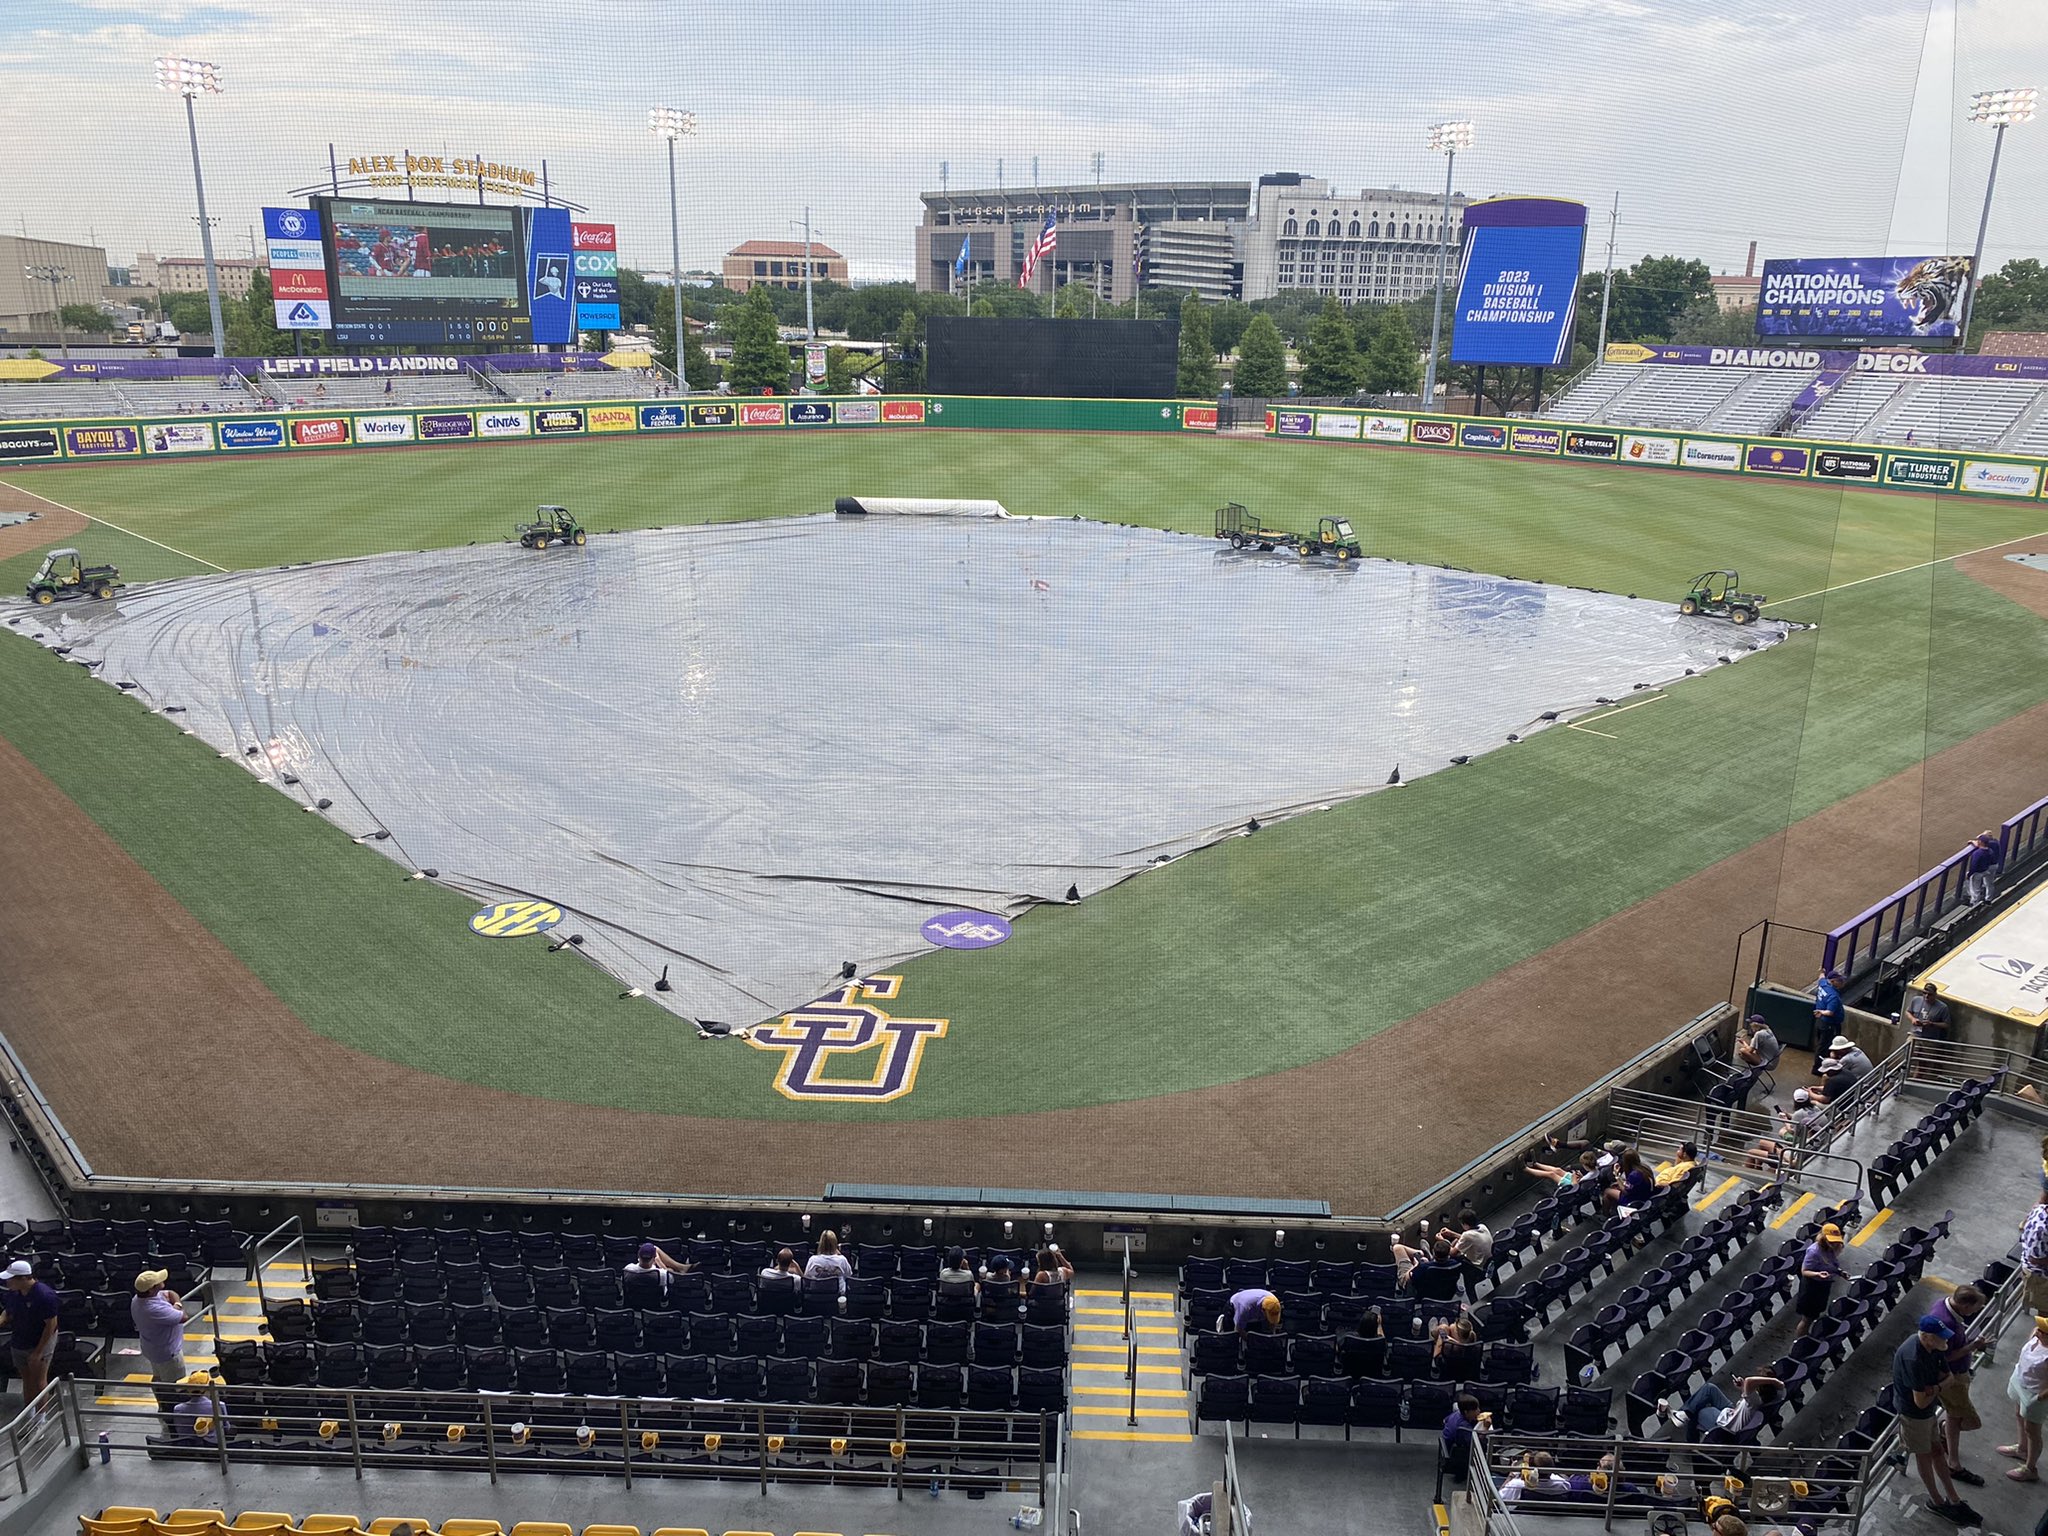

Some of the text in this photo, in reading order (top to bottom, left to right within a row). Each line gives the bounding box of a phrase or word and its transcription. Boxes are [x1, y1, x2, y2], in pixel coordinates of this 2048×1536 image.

[349, 155, 535, 187] ALEX BOX STADIUM
[369, 174, 523, 197] SKIP BERTMAN FIELD
[959, 206, 1004, 215] TIGER
[272, 249, 298, 258] PEOPLES
[576, 255, 615, 271] COX
[1498, 271, 1530, 283] 2023
[1767, 274, 1864, 289] NATIONAL
[602, 281, 612, 289] Lady
[1483, 284, 1543, 297] DIVISION I
[1764, 289, 1885, 305] CHAMPIONS
[1483, 297, 1539, 310] BASEBALL
[1466, 310, 1555, 323] CHAMPIONSHIP
[476, 321, 508, 332] 0 0 0
[1608, 346, 1645, 357] Community
[263, 356, 458, 373] LEFT FIELD LANDING
[1710, 348, 1821, 369] DIAMOND
[1857, 352, 1930, 373] DECK
[73, 363, 96, 372] LSU
[1994, 363, 2018, 371] LSU
[762, 387, 773, 396] 20
[699, 406, 727, 415] GOLD
[591, 411, 631, 423] MANDA
[225, 427, 278, 438] Window World
[302, 421, 339, 437] Acme
[364, 421, 406, 436] Worley
[1370, 424, 1402, 433] Acadian
[1417, 425, 1451, 440] DRAGO'S
[76, 431, 114, 443] BAYOU
[1513, 433, 1559, 445] TANKS-A-LOT
[1584, 440, 1613, 448] RENTALS
[1697, 451, 1735, 462] Cornerstone
[1909, 462, 1950, 475] TURNER
[1908, 471, 1949, 482] INDUSTRIES
[1987, 471, 2030, 485] accutemp
[472, 901, 561, 937] SEC
